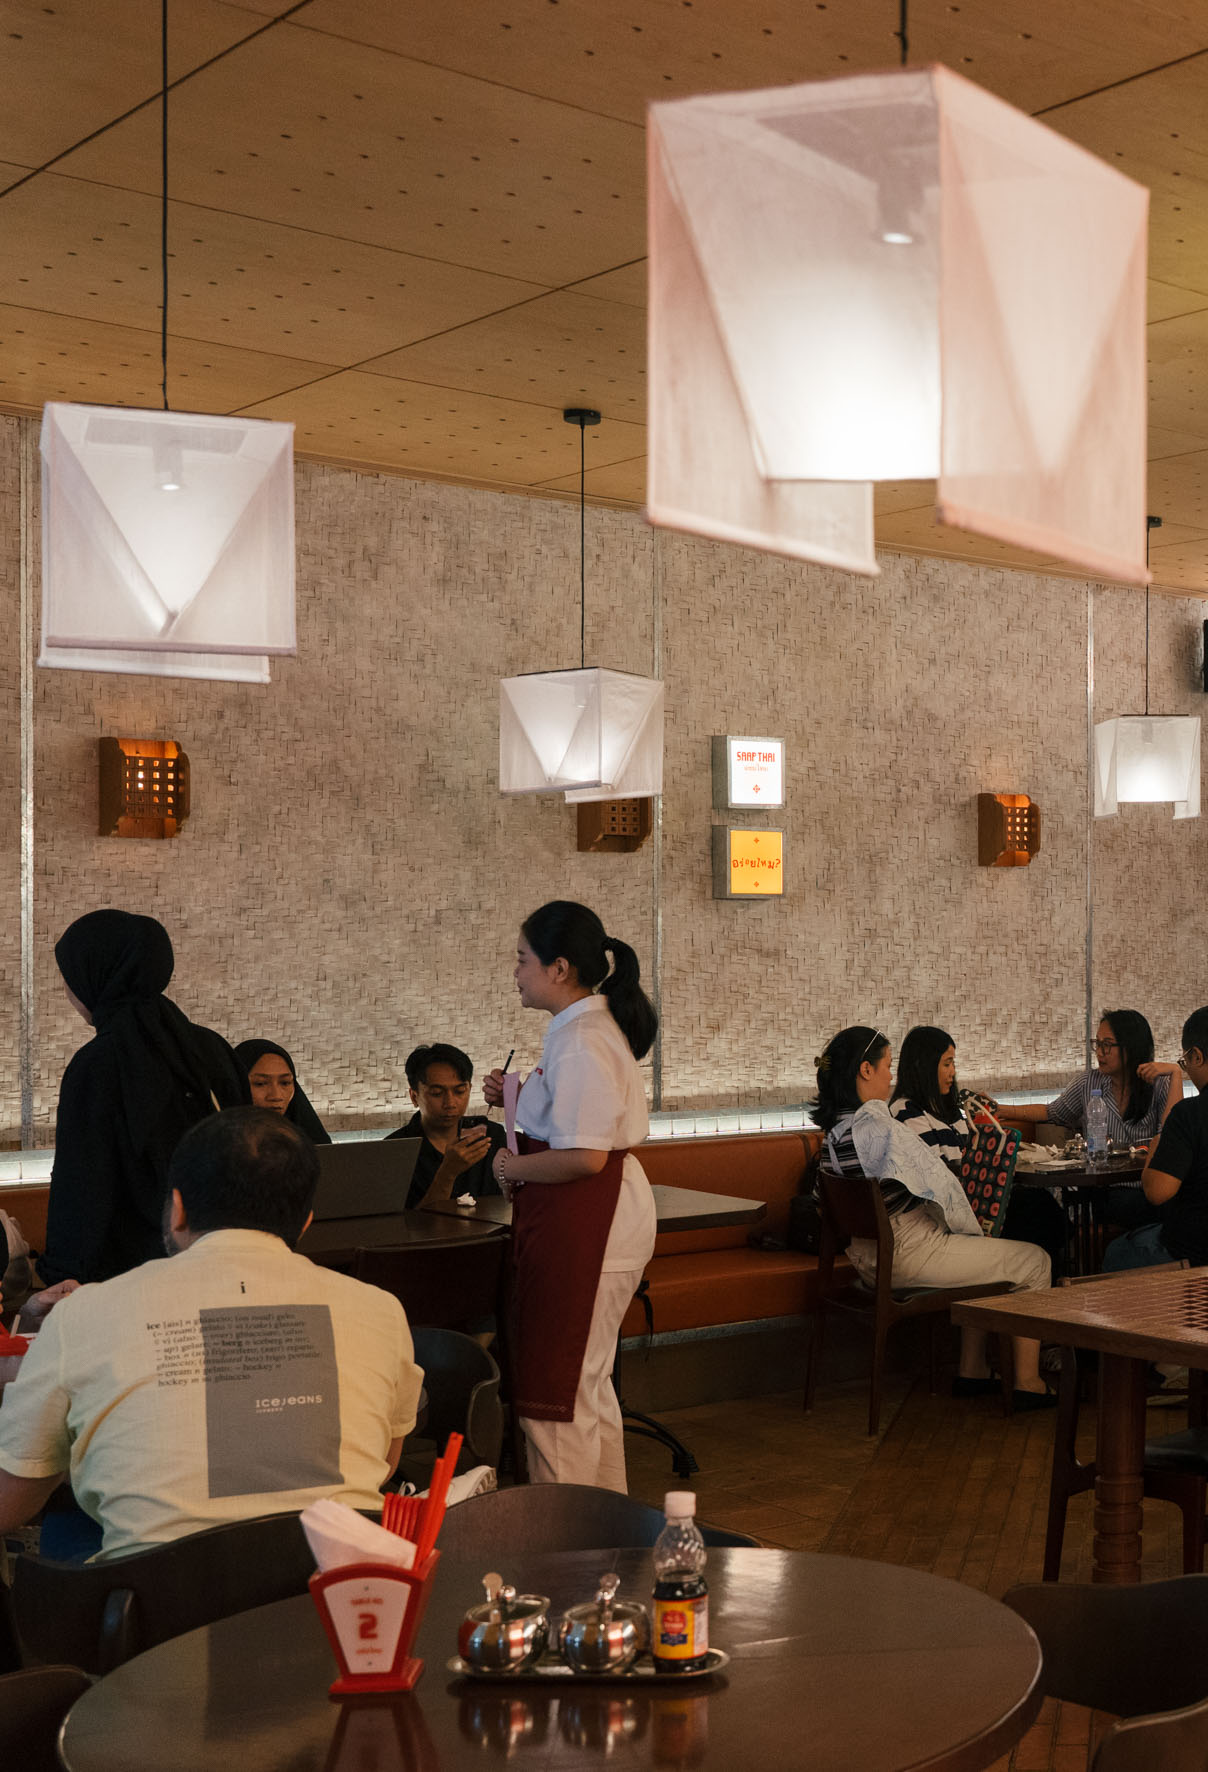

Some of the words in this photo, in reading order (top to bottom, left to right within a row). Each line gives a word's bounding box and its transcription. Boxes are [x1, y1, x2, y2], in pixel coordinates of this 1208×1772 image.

[736, 751, 757, 761] SAAP
[758, 752, 776, 762] THAI
[240, 1281, 247, 1294] i
[146, 1322, 161, 1330] ice
[358, 1613, 379, 1640] 2
